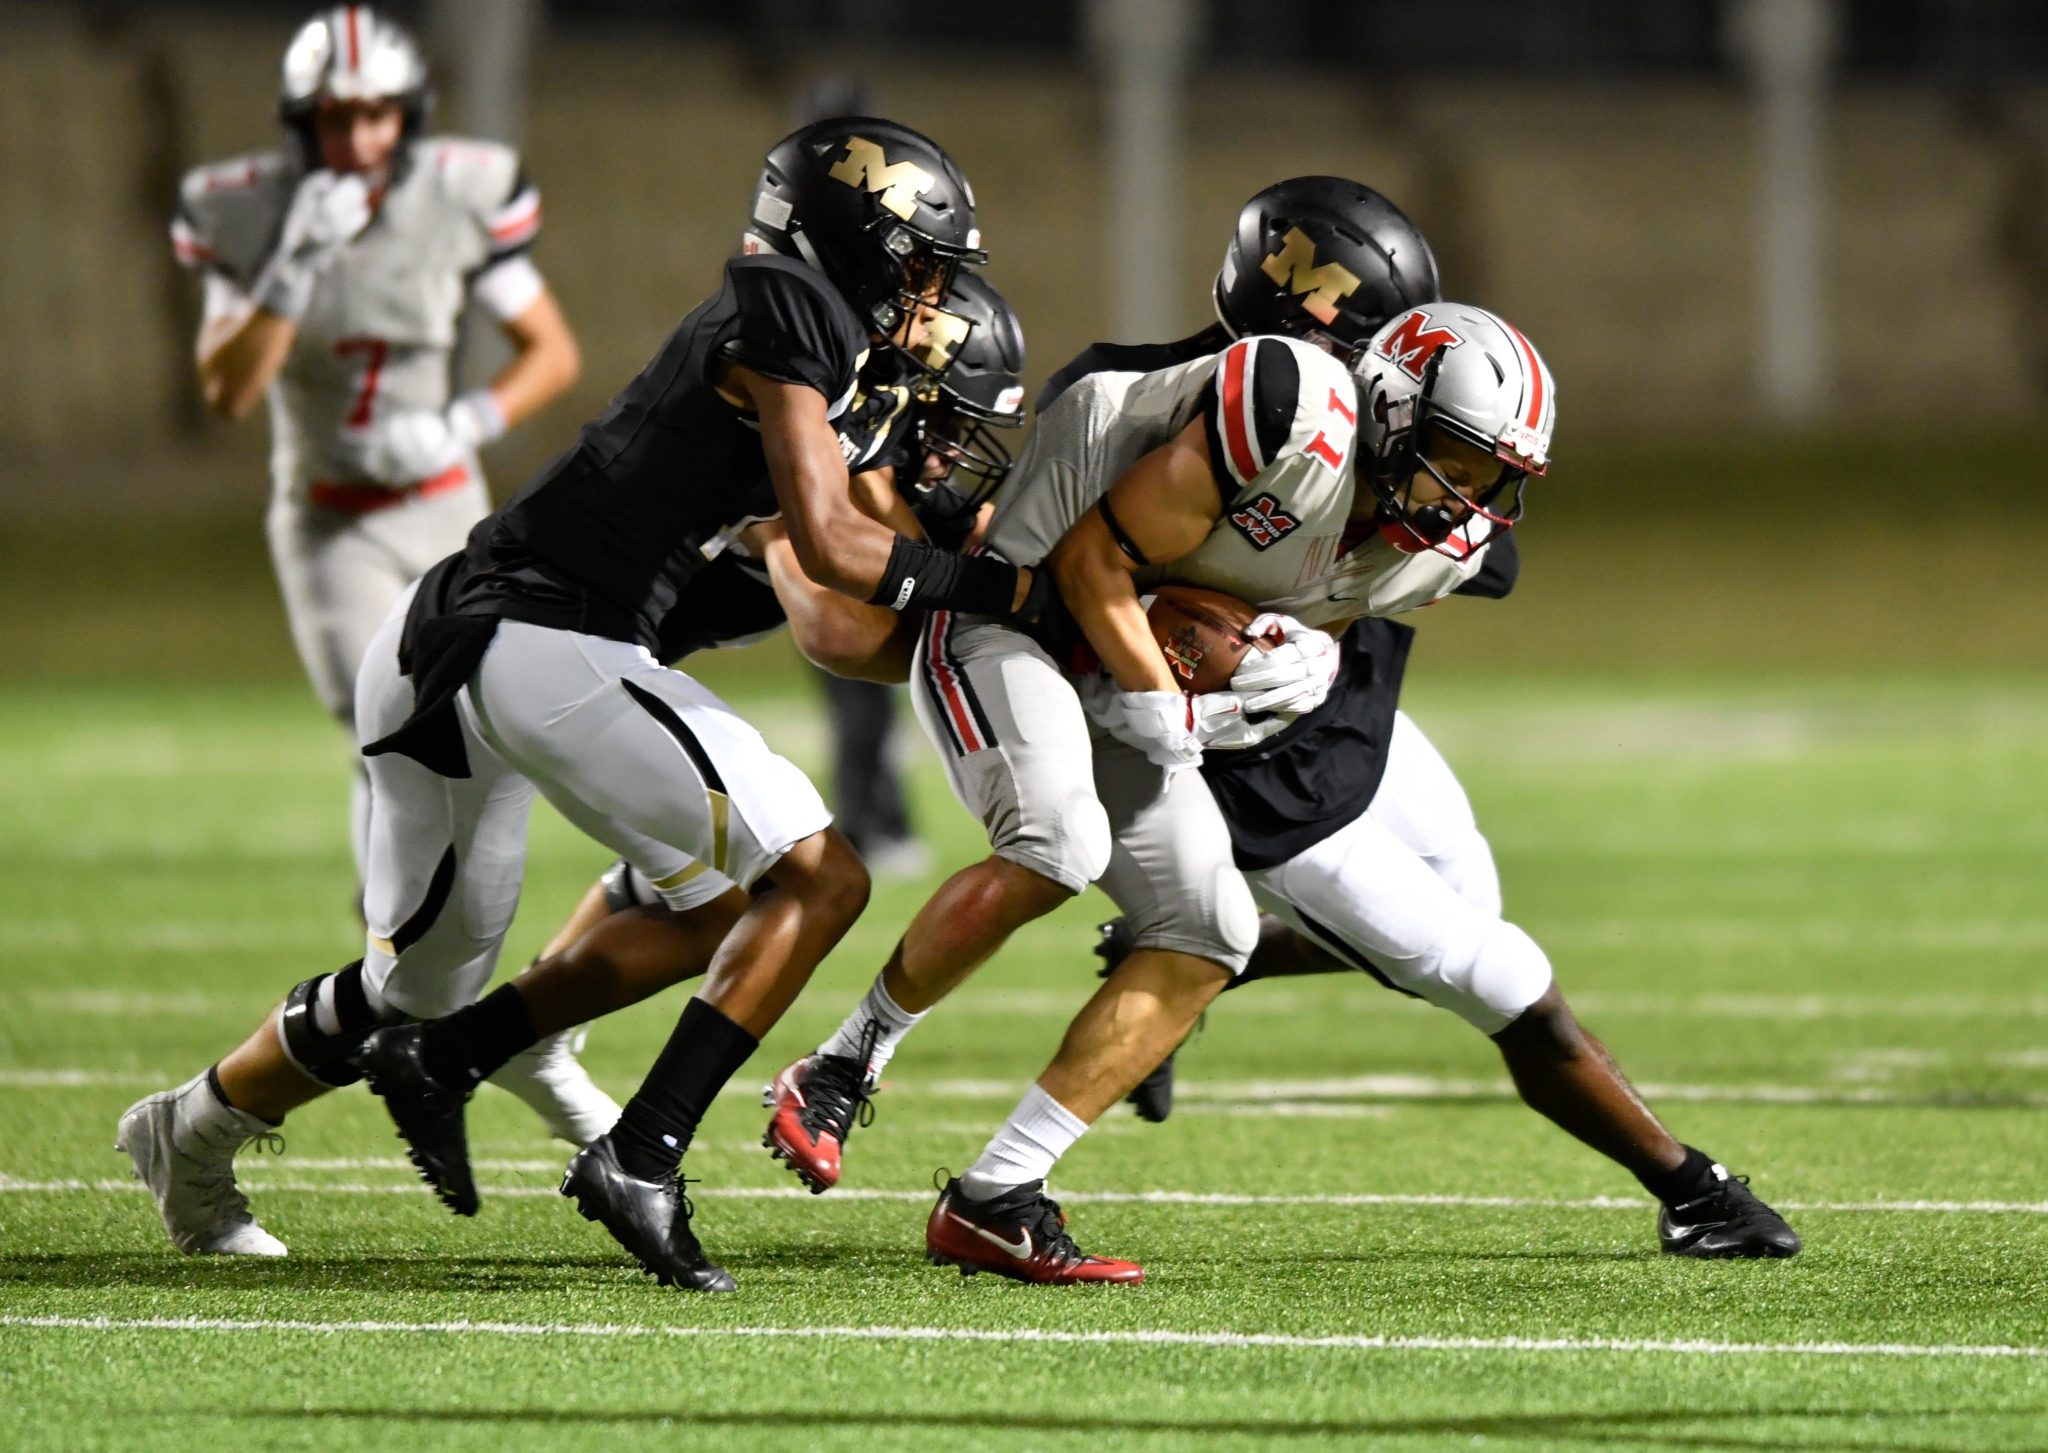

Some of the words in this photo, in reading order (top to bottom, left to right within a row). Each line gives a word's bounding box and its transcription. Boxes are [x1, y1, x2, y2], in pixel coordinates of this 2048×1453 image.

[829, 137, 935, 221] M
[1262, 228, 1361, 325] M
[335, 337, 392, 428] 7
[1374, 310, 1465, 384] M
[1303, 387, 1357, 470] 11
